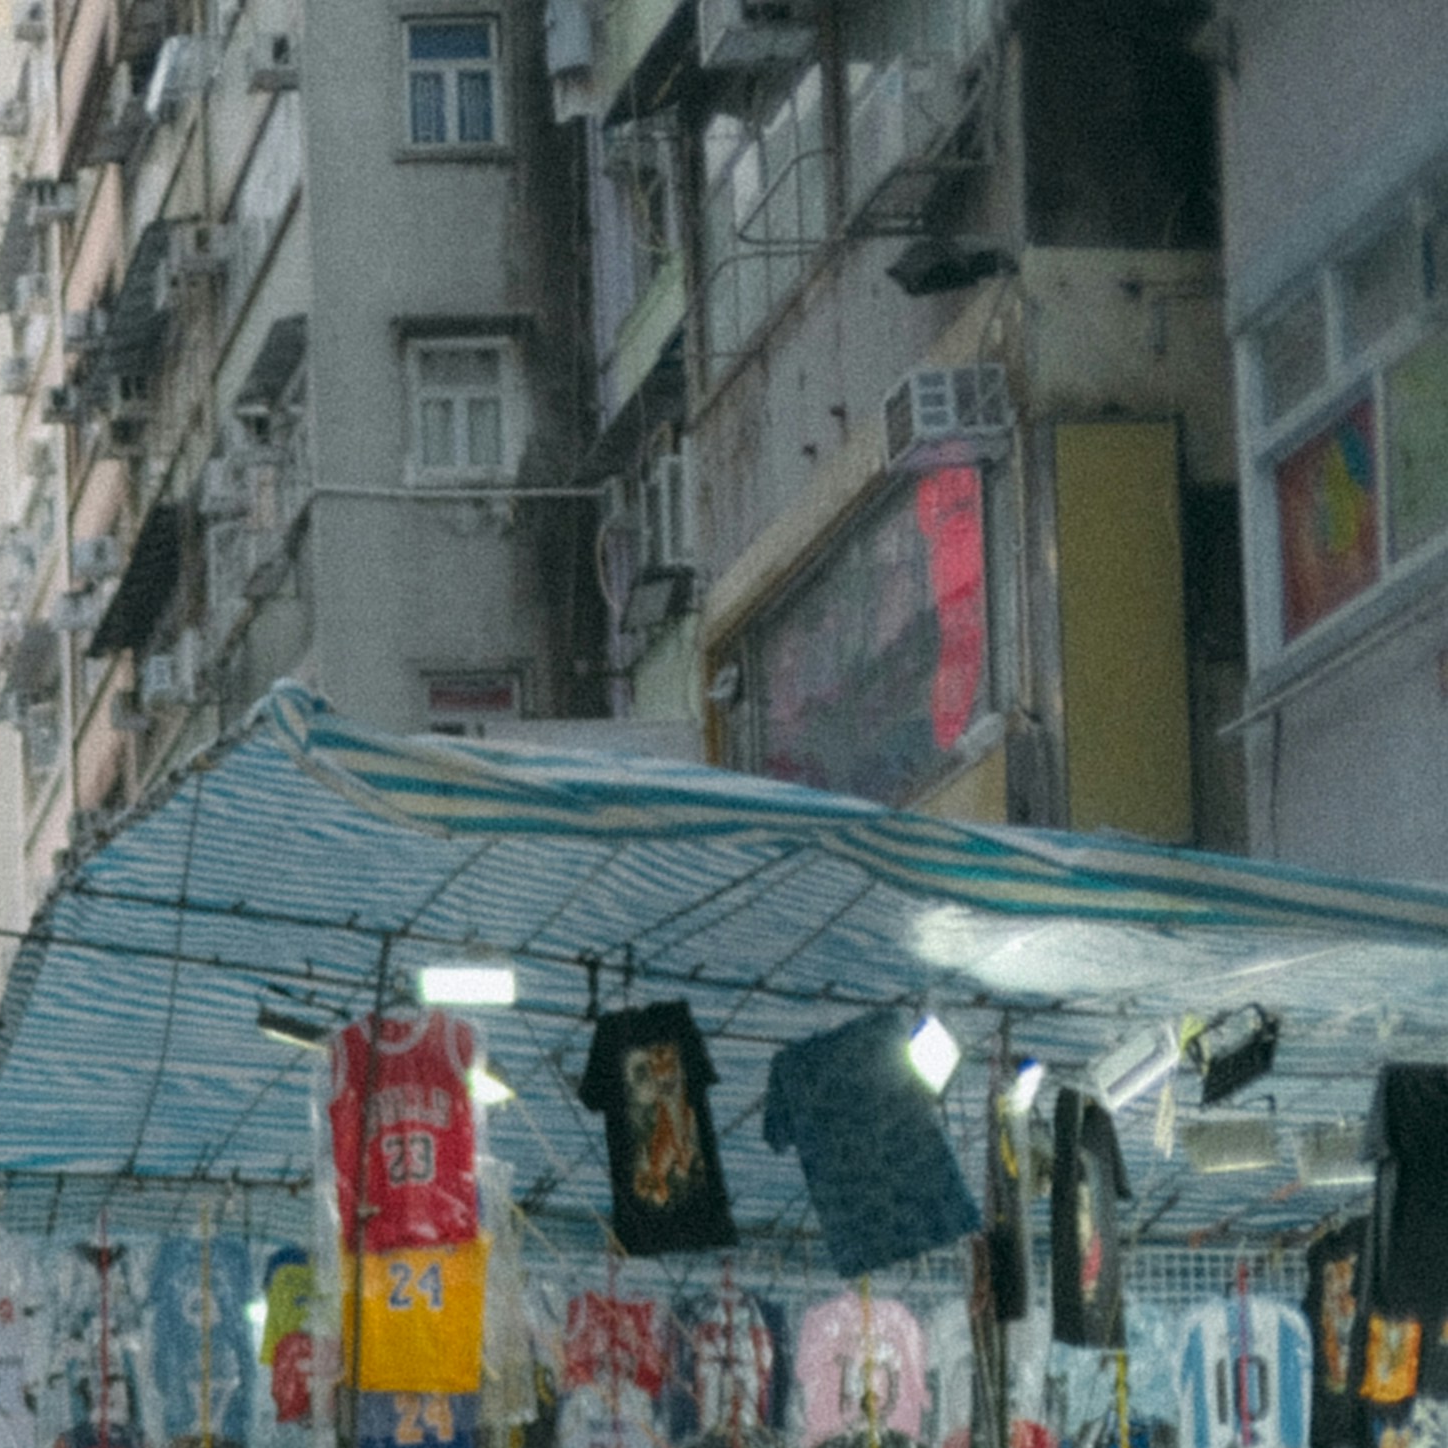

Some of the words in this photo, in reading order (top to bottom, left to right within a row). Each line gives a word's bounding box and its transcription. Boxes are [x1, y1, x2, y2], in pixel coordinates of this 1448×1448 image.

[382, 1131, 437, 1189] 23
[389, 1262, 445, 1312] 24
[1216, 1354, 1269, 1424] 10
[395, 1392, 454, 1446] 24
